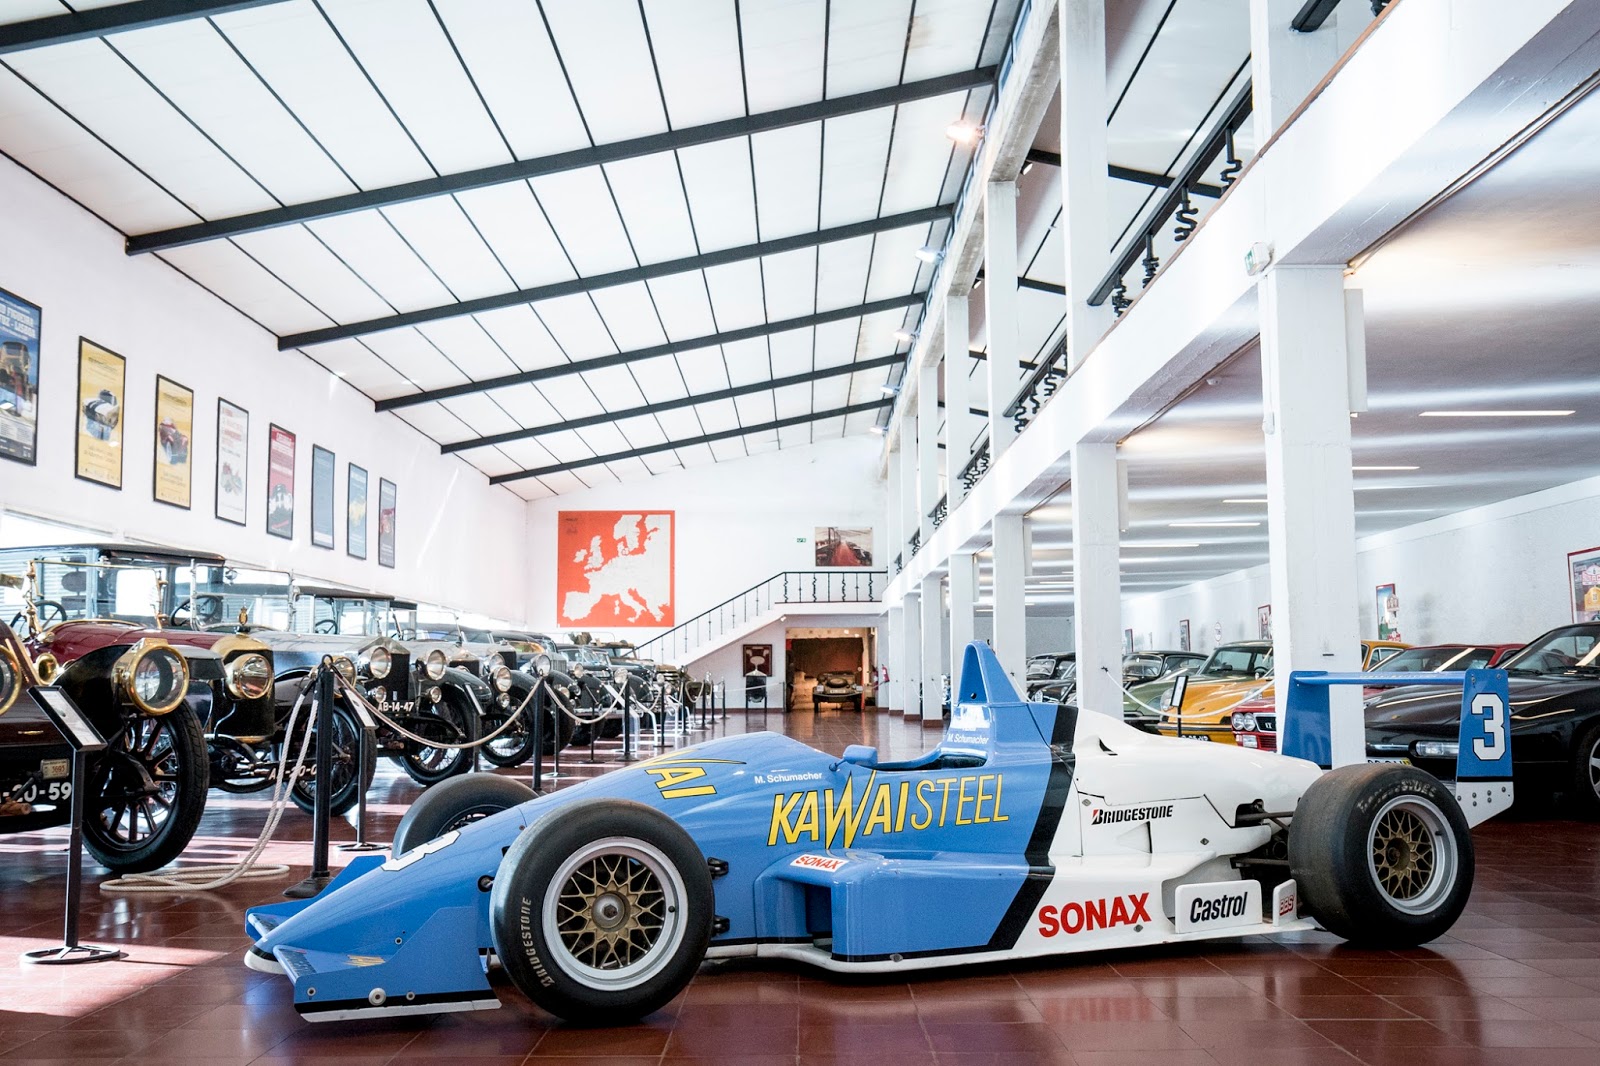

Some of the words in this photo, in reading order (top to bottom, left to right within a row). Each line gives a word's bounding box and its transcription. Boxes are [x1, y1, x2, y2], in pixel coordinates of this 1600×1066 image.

[378, 701, 415, 712] AB-14-47
[1471, 692, 1506, 761] 3
[954, 733, 990, 745] Schumacher
[754, 775, 766, 785] M.
[767, 771, 823, 784] Schumacher
[767, 768, 911, 851] KAWAI
[910, 773, 1010, 831] STEEL
[1091, 805, 1174, 825] BRIDGESTONE
[795, 855, 844, 870] SONAX
[1038, 892, 1152, 938] SONAX
[1189, 891, 1248, 924] Castrol
[1279, 894, 1295, 916] BBS
[519, 896, 556, 988] BRIDGESTONE
